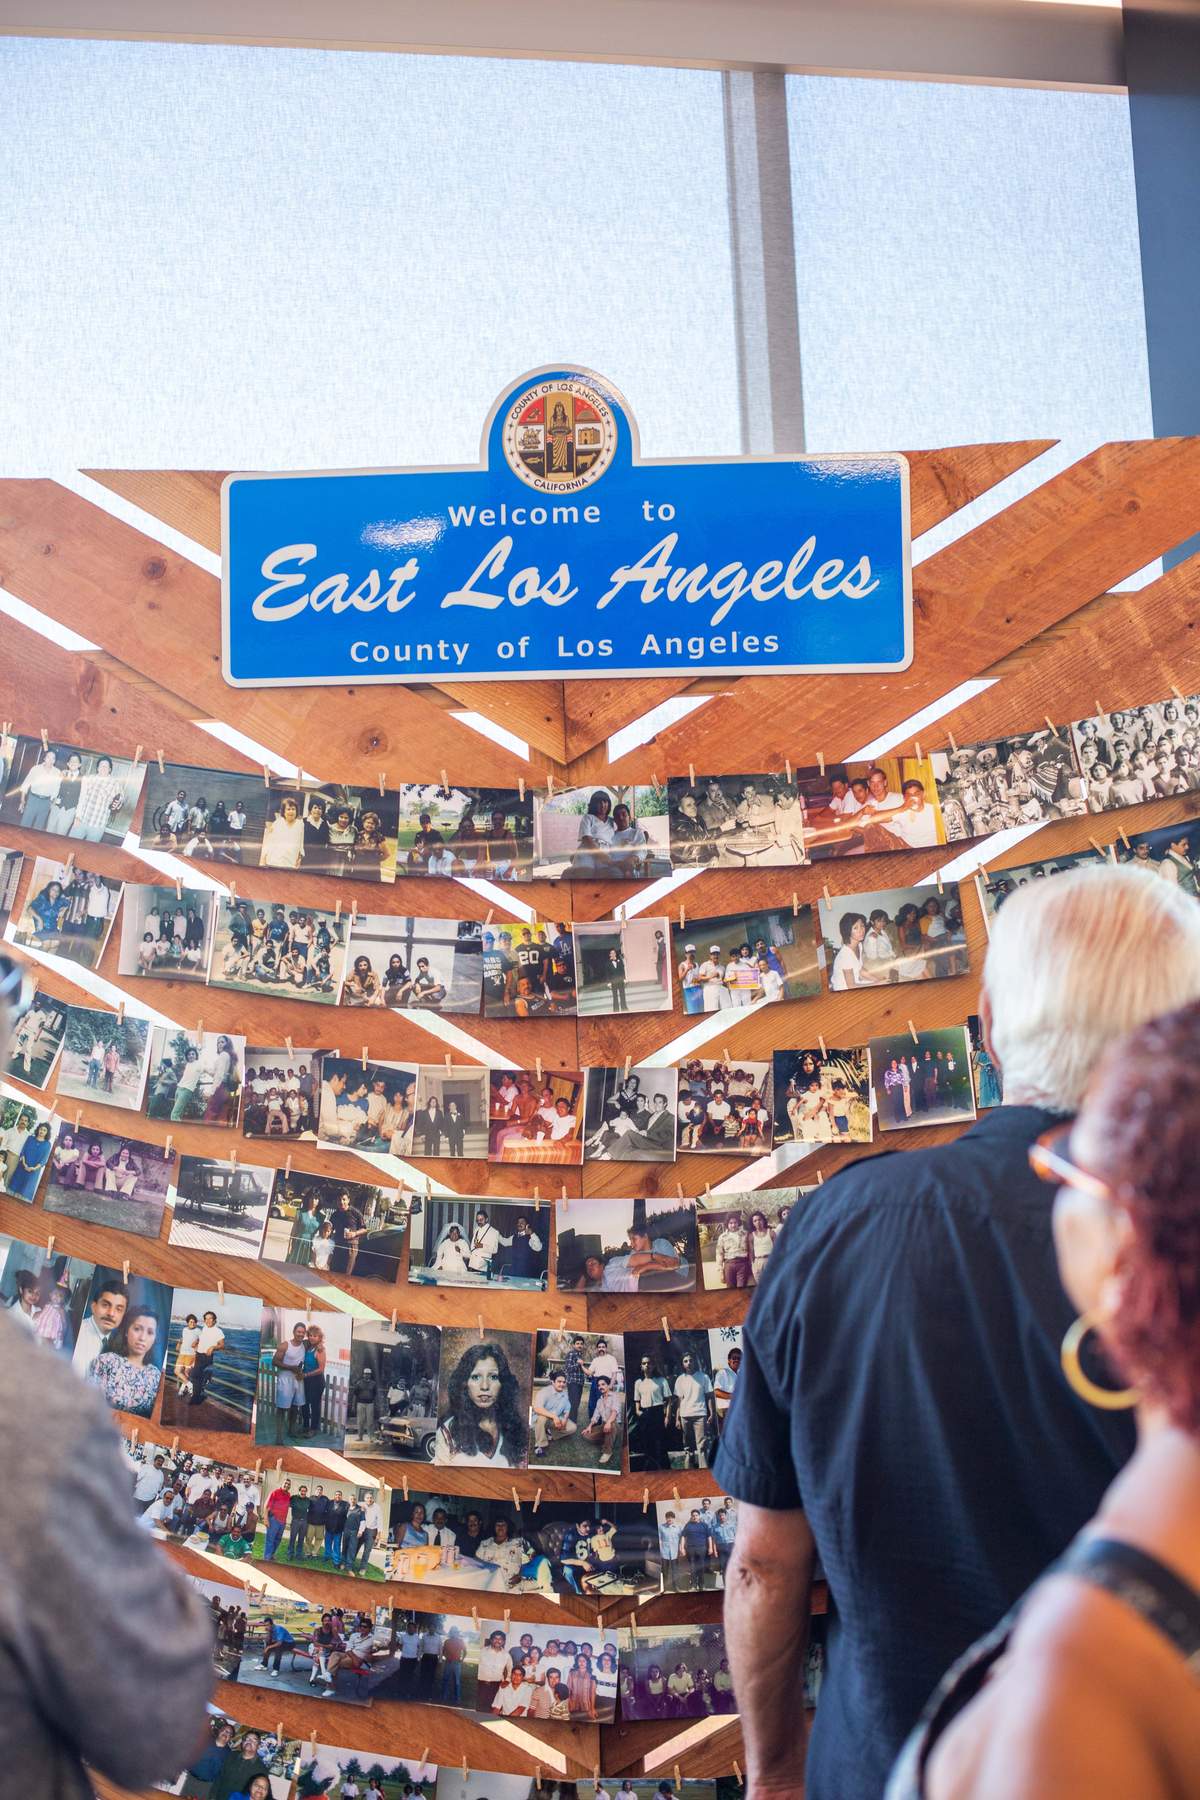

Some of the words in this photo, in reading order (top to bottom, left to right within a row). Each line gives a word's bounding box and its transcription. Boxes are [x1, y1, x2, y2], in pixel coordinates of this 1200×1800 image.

[511, 390, 539, 420] COUNTY
[541, 384, 554, 393] OF
[557, 383, 574, 392] LOS
[576, 388, 609, 417] ANGELES
[534, 478, 588, 491] CALIFORNIA
[448, 503, 600, 527] Welcome
[643, 501, 676, 522] to
[252, 543, 419, 622] East
[441, 535, 579, 609] Los
[597, 532, 880, 627] Angeles
[350, 640, 469, 665] County
[497, 637, 530, 659] of
[558, 636, 613, 657] Los
[641, 632, 779, 660] Angeles
[518, 950, 540, 965] 20
